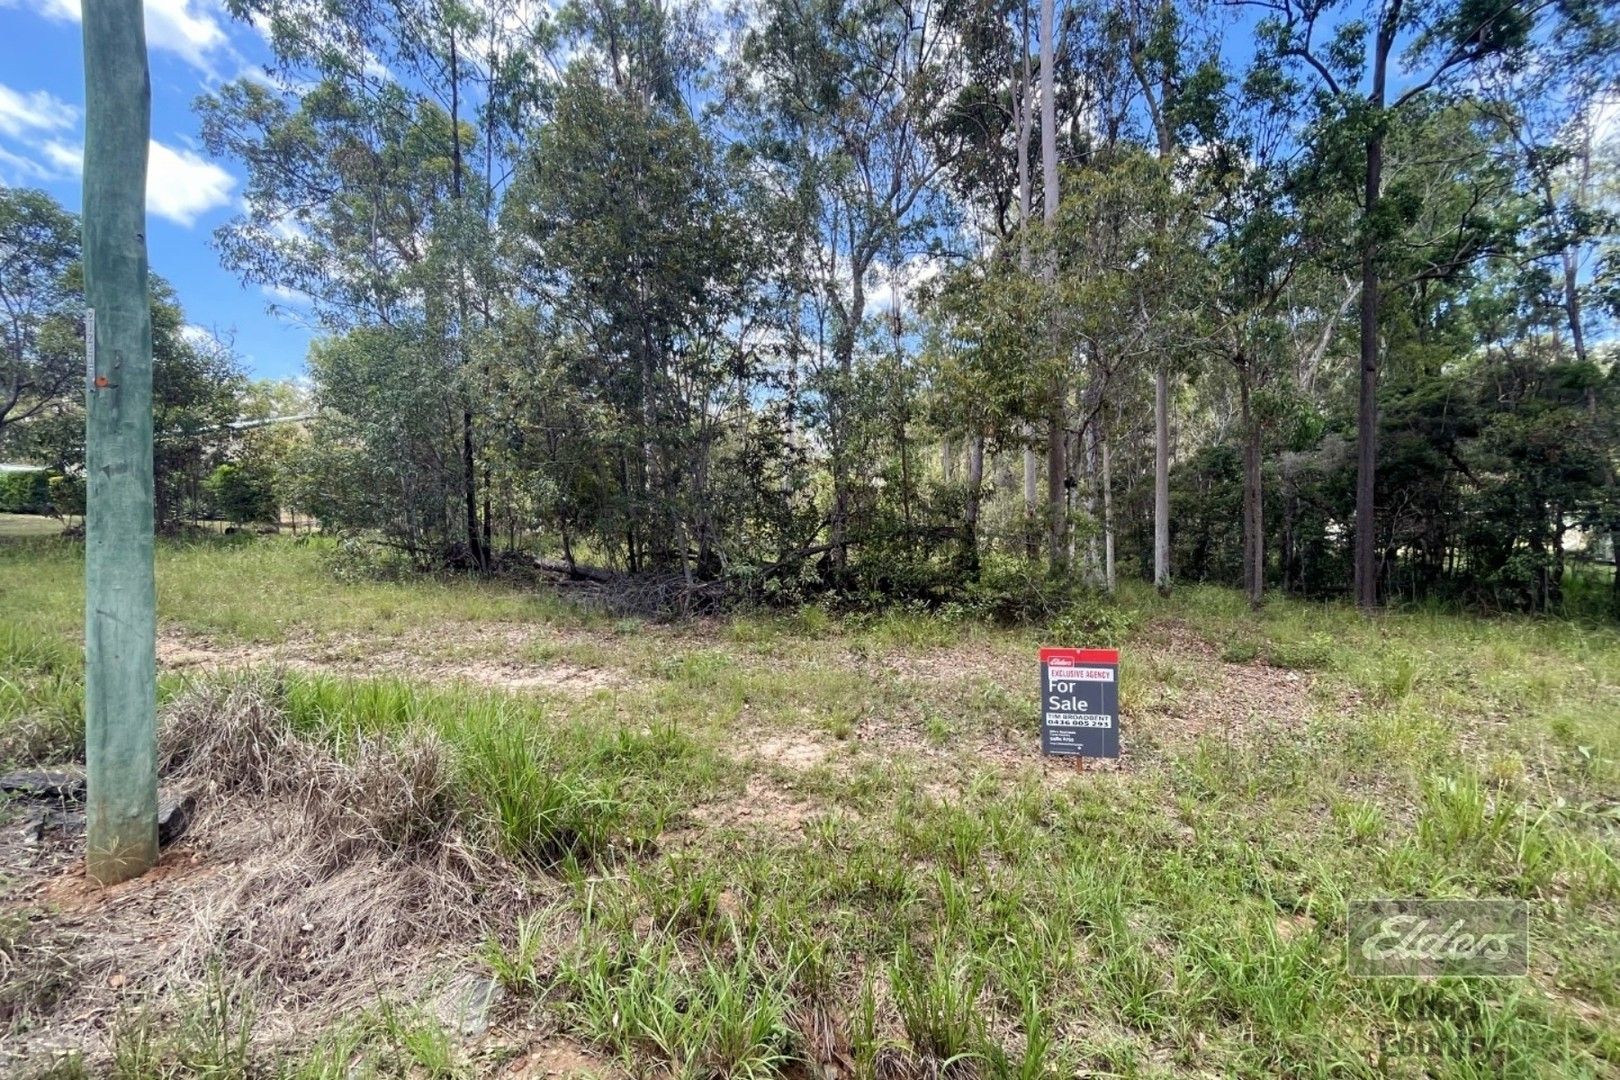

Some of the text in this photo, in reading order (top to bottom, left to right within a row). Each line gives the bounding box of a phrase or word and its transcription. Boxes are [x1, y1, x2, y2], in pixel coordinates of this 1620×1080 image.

[1051, 669, 1110, 680] EXCLUSIVE AGENCY
[1049, 680, 1076, 693] For
[1049, 696, 1088, 711] Sale
